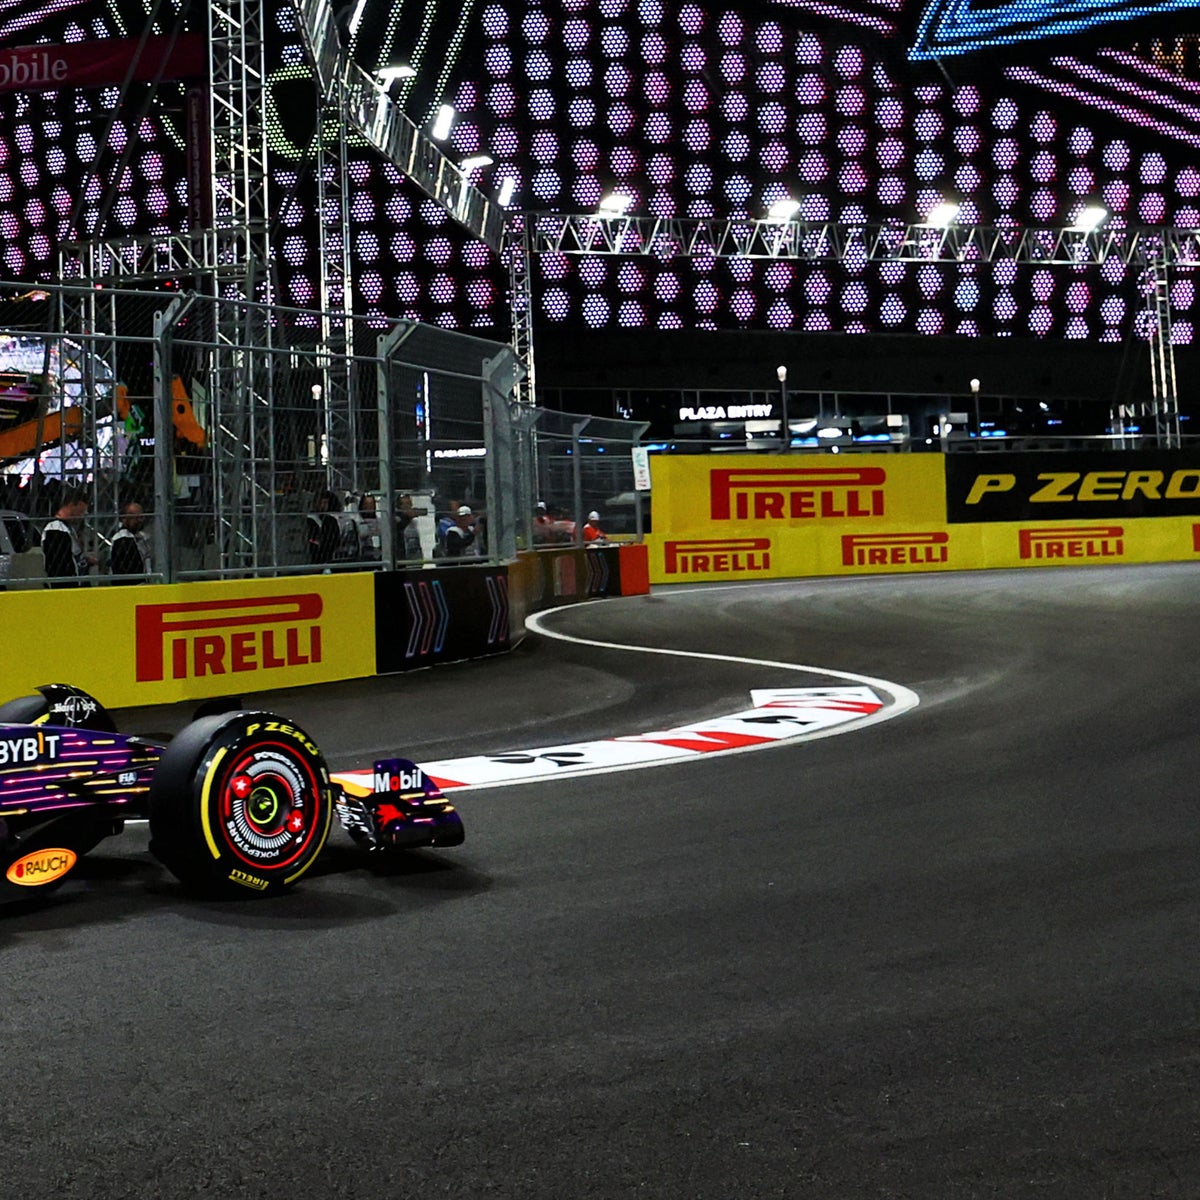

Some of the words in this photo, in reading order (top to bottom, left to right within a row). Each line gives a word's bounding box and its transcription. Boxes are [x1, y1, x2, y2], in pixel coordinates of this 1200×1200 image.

[680, 406, 726, 420] PLAZA
[727, 404, 772, 418] ENTRY
[710, 467, 886, 520] PIRELLI
[965, 474, 1016, 504] P
[1029, 469, 1200, 503] ZERO
[664, 538, 771, 574] PIRELLI
[841, 532, 949, 567] PIRELLI
[1019, 526, 1124, 559] PIRELLI
[135, 593, 324, 683] PIRELLI
[246, 723, 260, 736] P
[264, 721, 319, 756] ZERO
[375, 769, 423, 793] Mobil
[26, 855, 69, 876] RAUCH
[228, 869, 269, 891] PIRELLI
